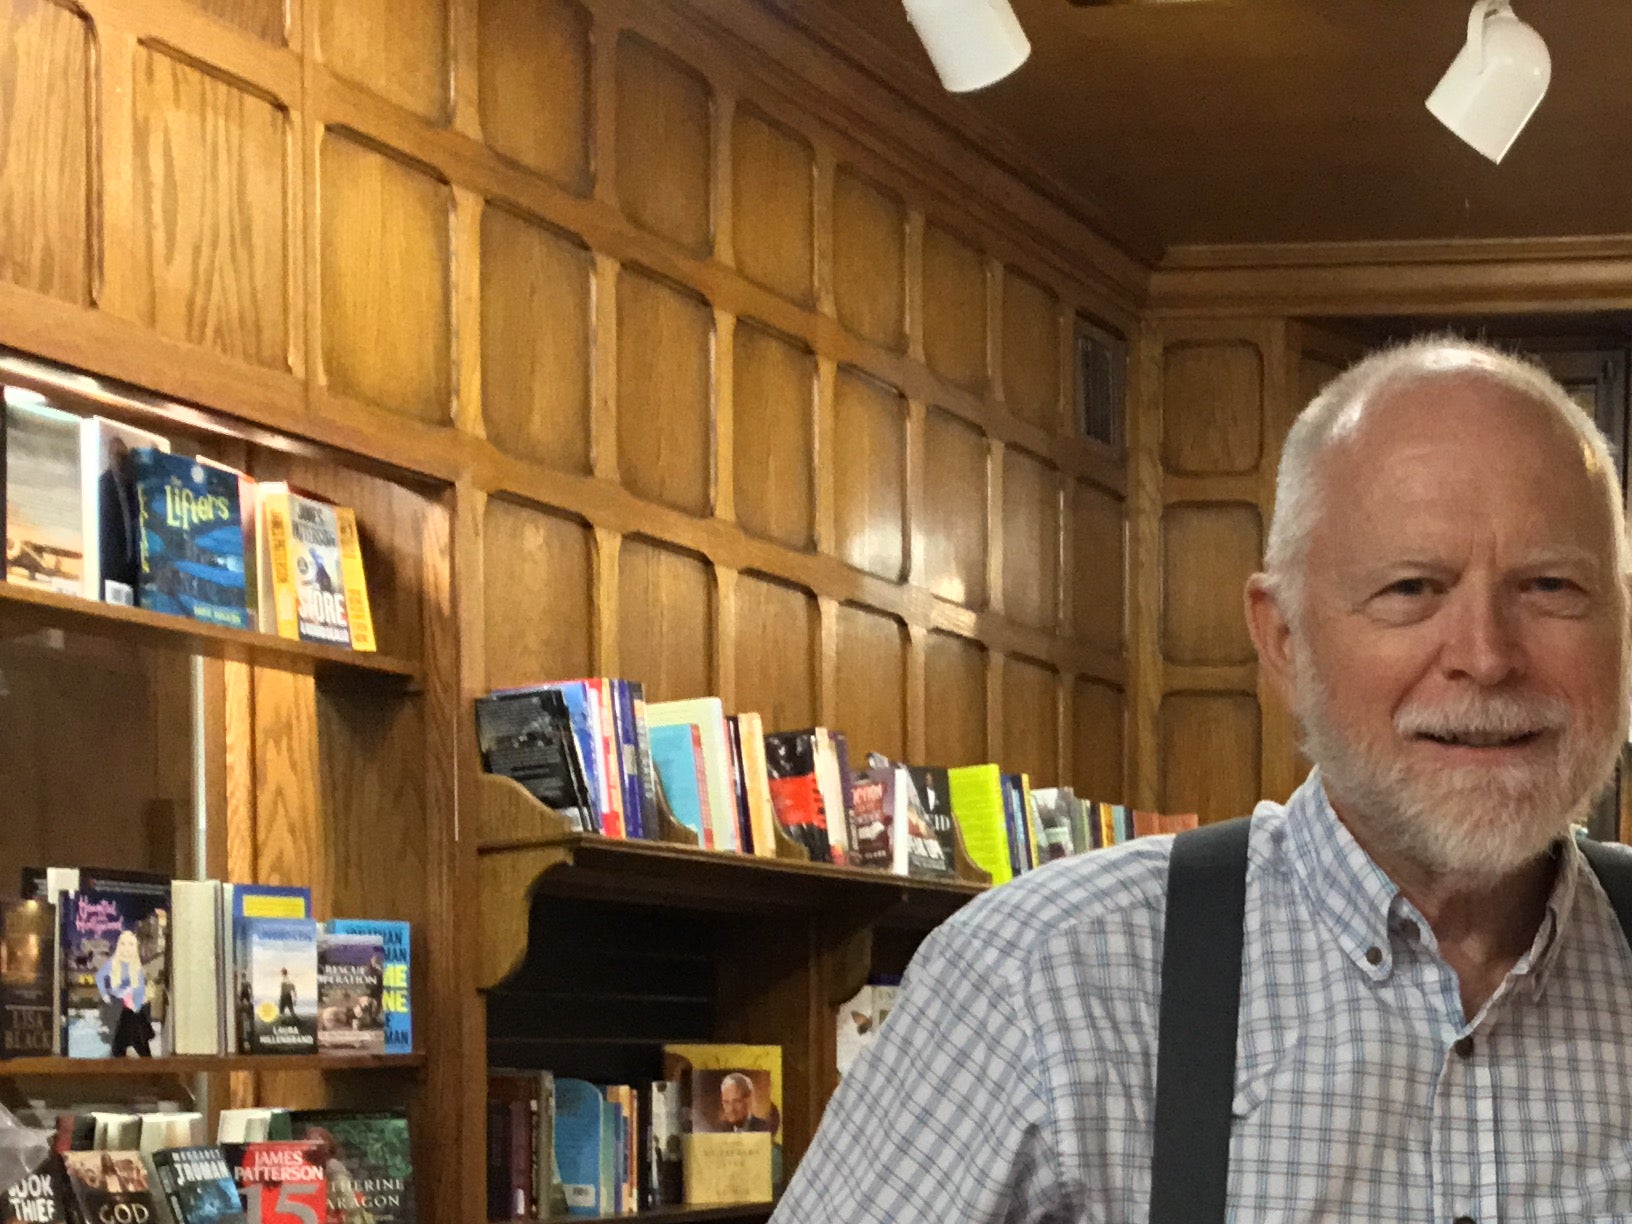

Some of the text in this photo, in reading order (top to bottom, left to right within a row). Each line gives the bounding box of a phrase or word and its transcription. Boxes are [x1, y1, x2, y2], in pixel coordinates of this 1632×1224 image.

[164, 484, 231, 531] Lifters
[254, 1150, 303, 1166] JAMES
[234, 1165, 324, 1182] PATTERSON
[9, 1198, 56, 1224] THIEF
